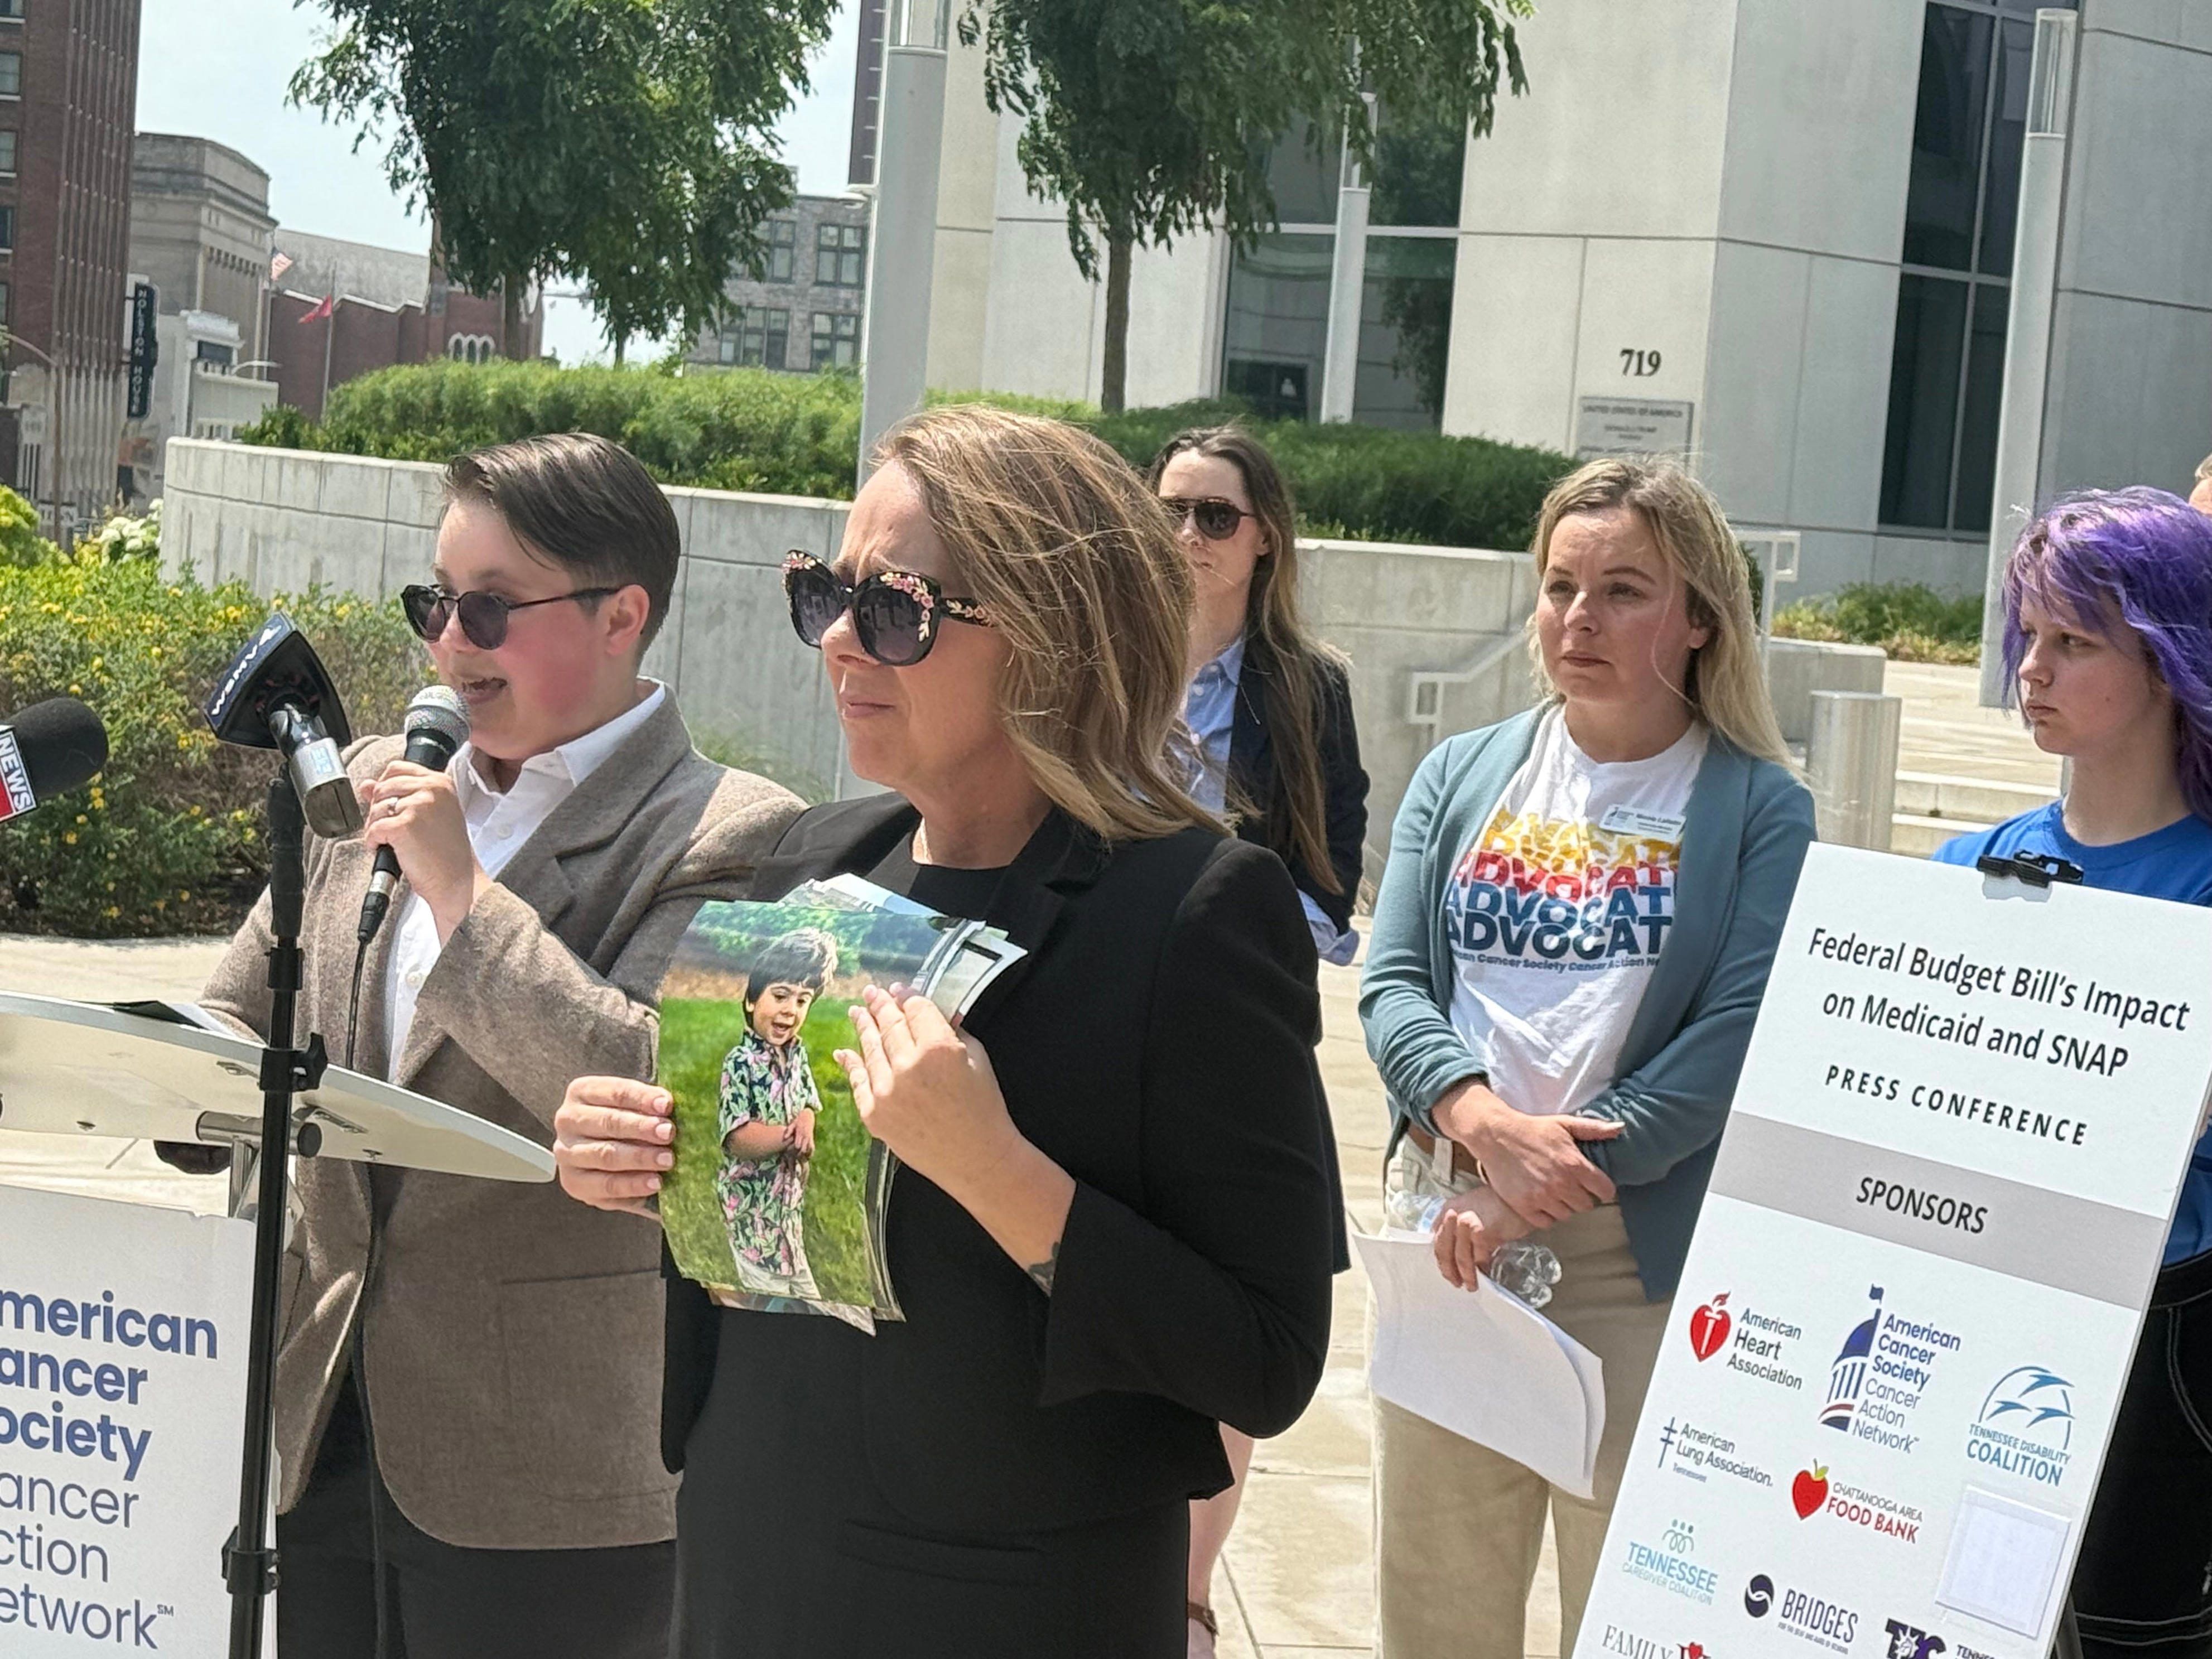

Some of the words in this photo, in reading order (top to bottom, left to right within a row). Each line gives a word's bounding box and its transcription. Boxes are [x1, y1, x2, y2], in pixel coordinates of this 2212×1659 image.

[1620, 349, 1661, 377] 719
[0, 736, 32, 812] NEWS
[1478, 953, 1522, 968] Cancer
[1522, 958, 1568, 974] Society
[1808, 928, 1906, 972] Federal
[1909, 947, 2006, 995] Budget
[2084, 981, 2190, 1031] Impact
[1823, 993, 1855, 1019] on
[1861, 994, 1984, 1047] Medicaid
[1987, 1029, 2044, 1060] and
[2047, 1034, 2128, 1077] SNAP
[1825, 1065, 1900, 1101] PRESS
[1911, 1085, 2088, 1145] CONFERENCE
[1856, 1176, 1988, 1234] SPONSORS
[0, 1290, 218, 1359] merican
[1740, 1308, 1801, 1340] American
[1883, 1313, 1960, 1351] American
[1734, 1328, 1782, 1361] Heart
[1878, 1334, 1936, 1365] Cancer
[0, 1346, 148, 1405] ancer
[1727, 1353, 1803, 1390] Association
[1872, 1354, 1931, 1392] Society
[1866, 1378, 1921, 1409] Cancer
[1858, 1399, 1905, 1429] Action
[0, 1401, 152, 1481] ociety
[1676, 1439, 1704, 1466] Lung
[1680, 1422, 1735, 1454] American
[1969, 1424, 2020, 1449] TENNESSEE
[2020, 1440, 2071, 1464] DISABILITY
[1967, 1439, 2063, 1487] COALITION
[0, 1472, 139, 1528] ancer
[1827, 1496, 1872, 1526] FOOD
[1874, 1513, 1919, 1544] BANK
[1898, 1506, 1922, 1522] AREA
[1628, 1541, 1718, 1594] TENNESSEE
[1781, 1589, 1858, 1643] BRIDGES
